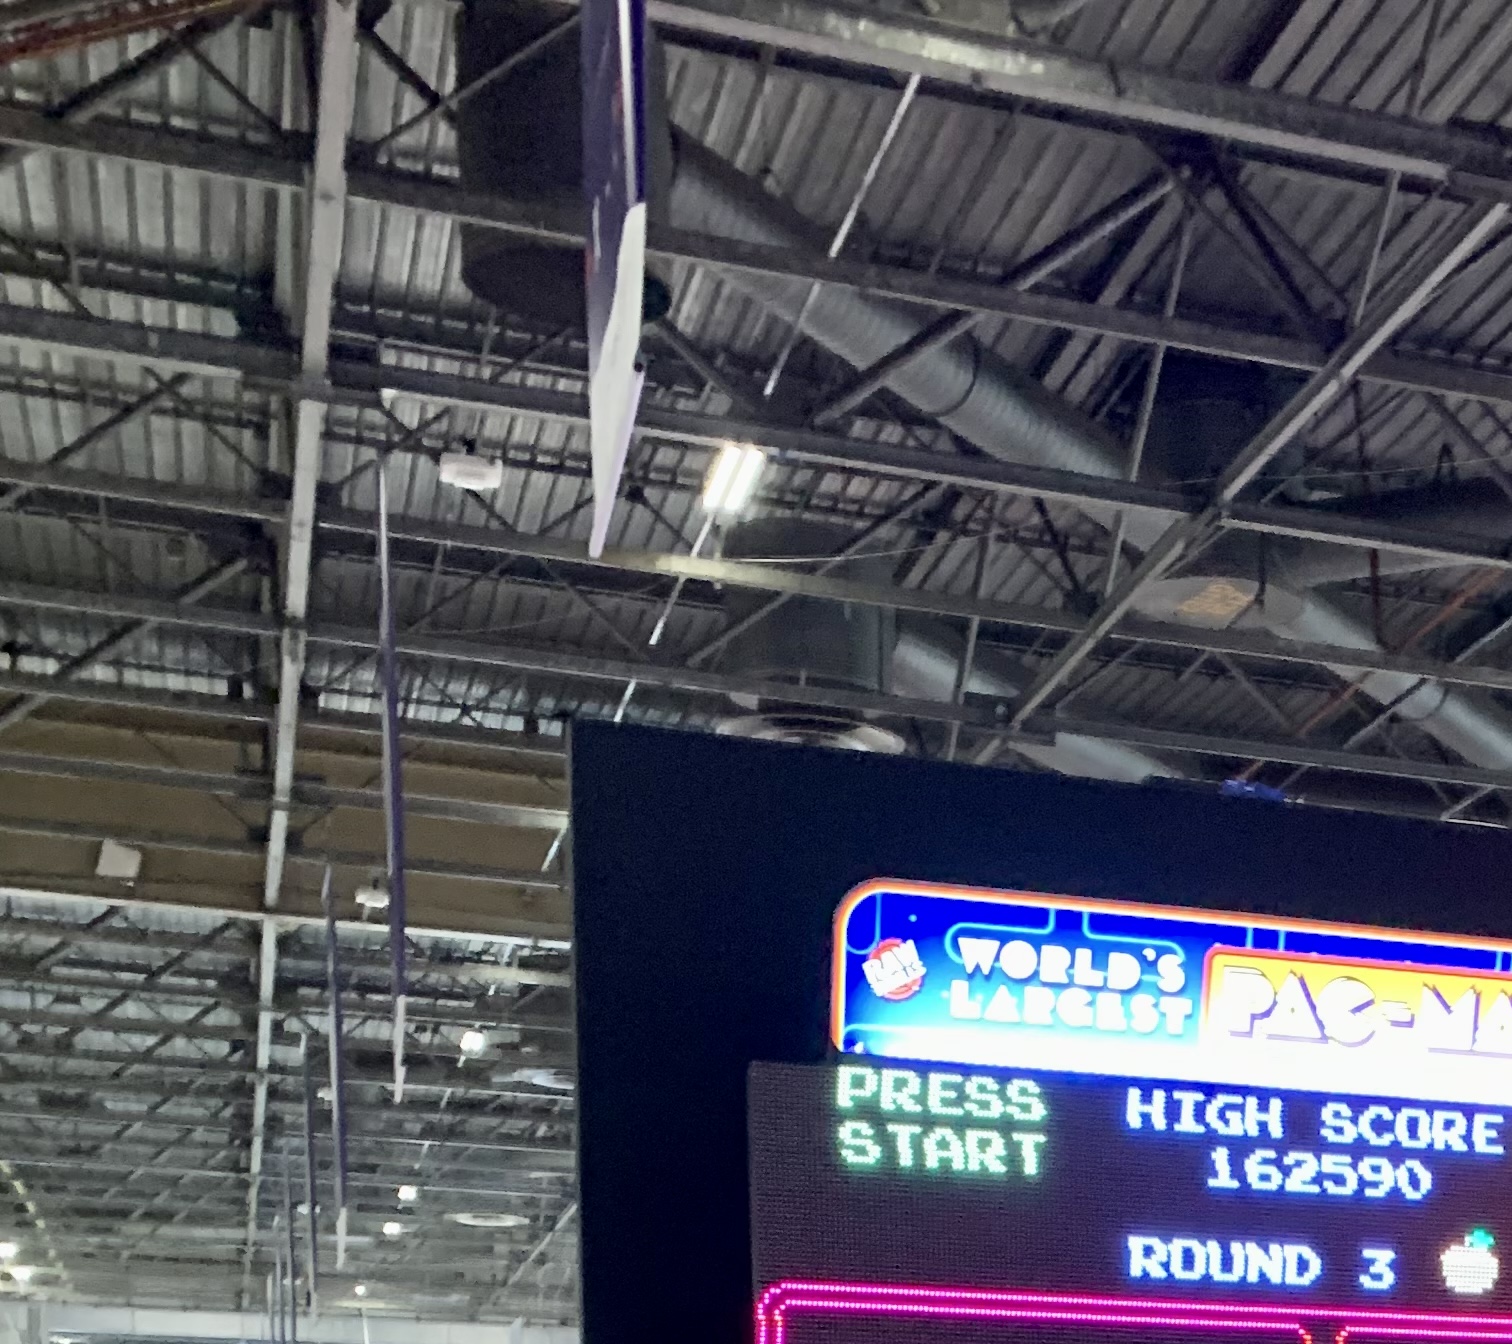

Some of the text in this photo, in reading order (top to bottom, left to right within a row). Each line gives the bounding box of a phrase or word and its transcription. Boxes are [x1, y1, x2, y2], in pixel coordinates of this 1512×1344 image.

[957, 937, 1187, 993] WORLD'S
[950, 980, 1193, 1035] LARGEST
[836, 1066, 1048, 1121] PRESS
[1126, 1087, 1504, 1154] HIGH SCORE
[838, 1120, 1048, 1175] START
[1207, 1147, 1432, 1199] 162590
[1127, 1236, 1396, 1289] ROUND 3
